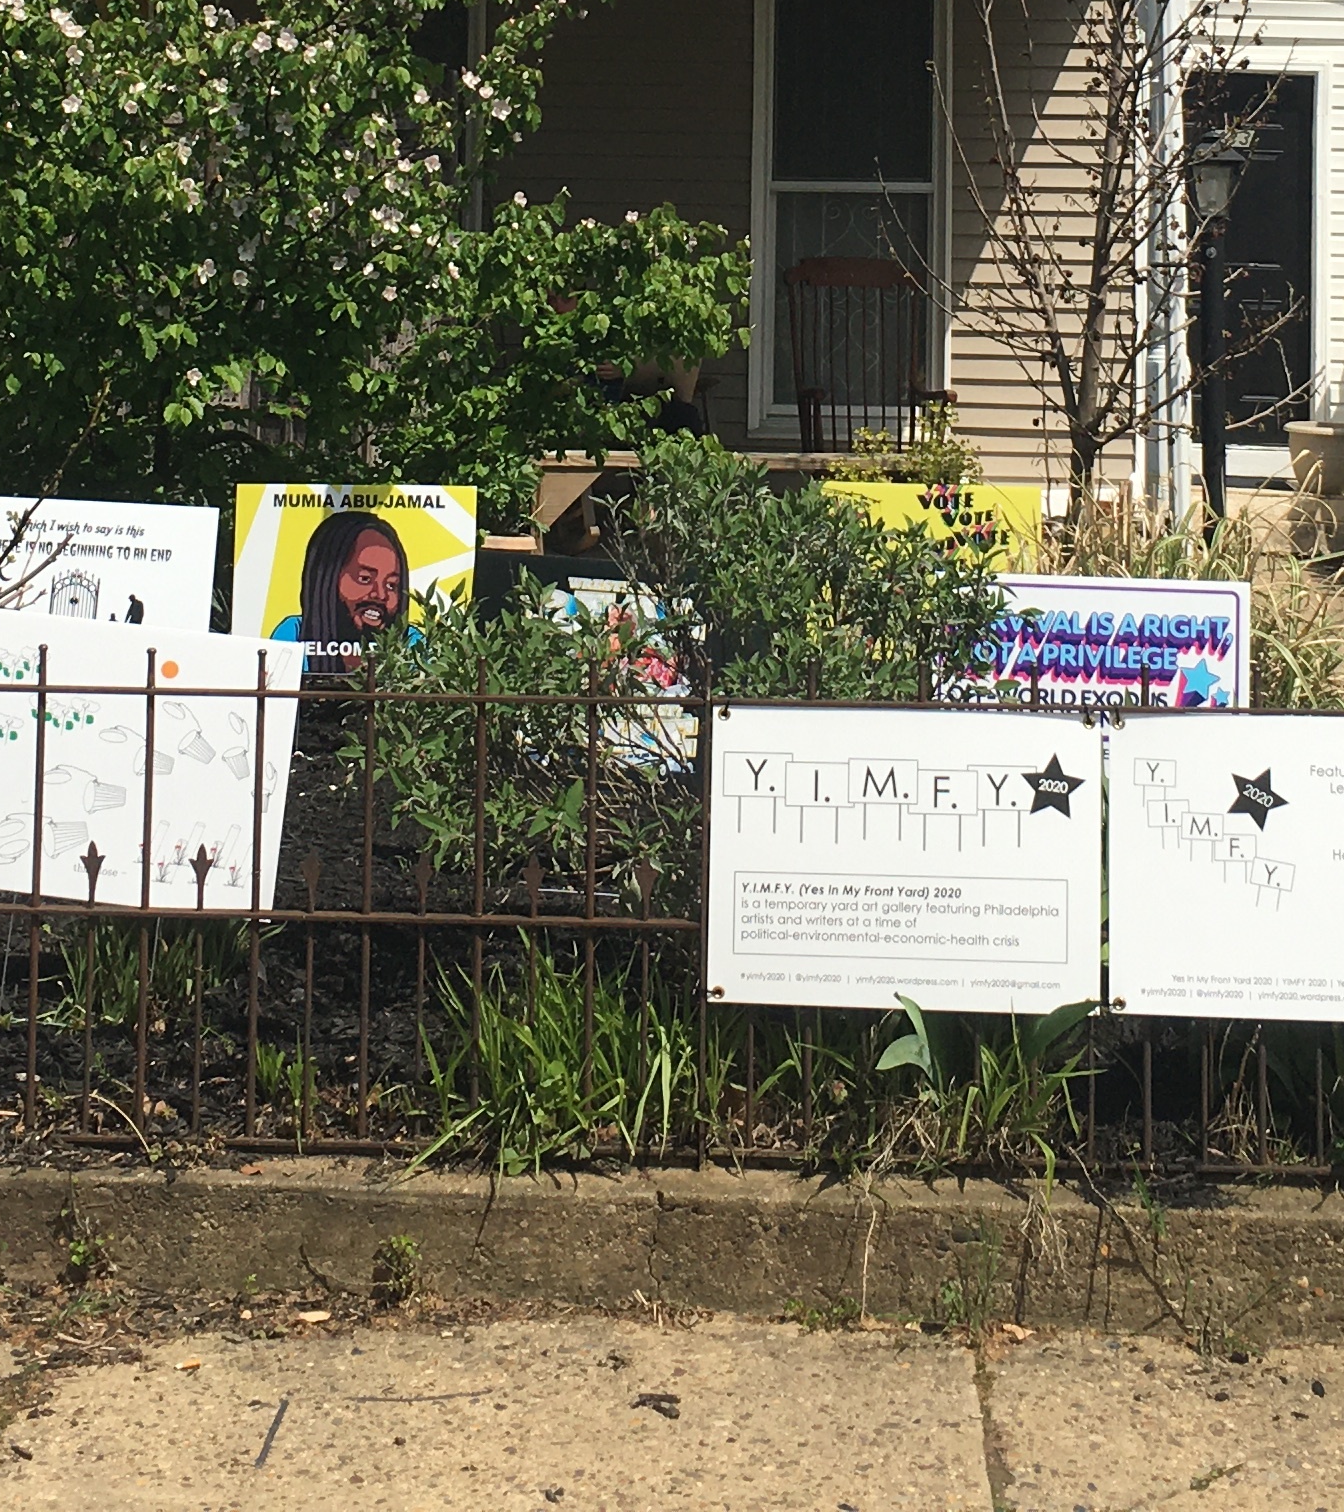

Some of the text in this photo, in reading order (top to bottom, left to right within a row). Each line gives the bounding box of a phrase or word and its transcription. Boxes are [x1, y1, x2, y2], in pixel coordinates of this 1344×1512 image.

[273, 494, 446, 509] MUMIA ABU-JAMAL
[916, 492, 975, 509] VOTE
[26, 519, 145, 538] hich I wish to say is this
[941, 509, 994, 527] VOTE
[38, 541, 53, 554] NO
[117, 546, 130, 560] TO
[133, 548, 147, 561] AN
[150, 549, 172, 562] END
[1091, 612, 1114, 637] IS
[1119, 613, 1139, 638] A
[1143, 614, 1234, 646] RIGHT,
[973, 640, 1179, 671] OT A PRIVILEGE
[1146, 761, 1165, 783] Y.
[744, 758, 775, 792] Y.
[862, 765, 909, 799] M.
[933, 776, 958, 809] F.
[985, 773, 1017, 807] Y.
[1038, 777, 1069, 795] 2020
[1242, 783, 1274, 808] 2020
[1189, 816, 1218, 837] M.
[1229, 837, 1244, 858] F.
[1264, 863, 1281, 887] Y.
[741, 882, 962, 900] Y.I.M.F.Y. (Yes In My Front Yard) 2020
[741, 897, 1059, 918] is a temporary yard art gallery featuring Philadelphia
[741, 913, 917, 928] artists and writers at a time of
[741, 929, 1020, 947] political-environmental-economic-health crisis
